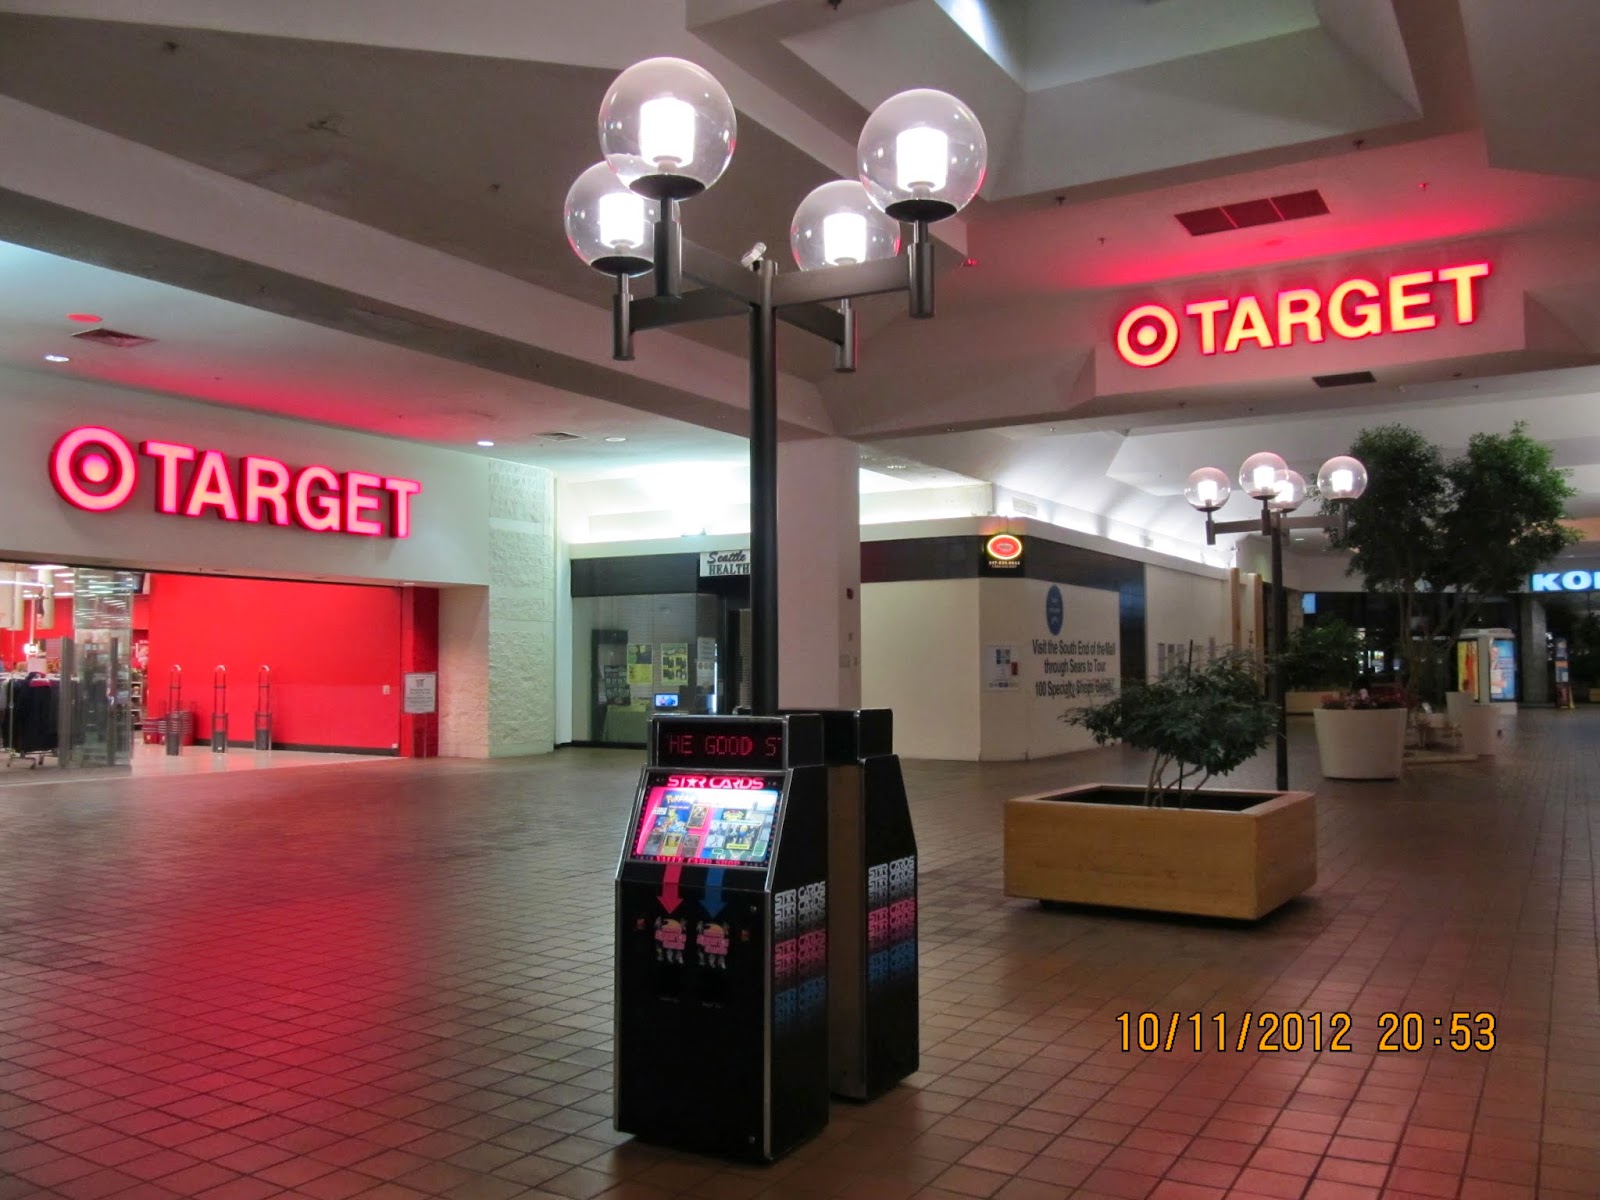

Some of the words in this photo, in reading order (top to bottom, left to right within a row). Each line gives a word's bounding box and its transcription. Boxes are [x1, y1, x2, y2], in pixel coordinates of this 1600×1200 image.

[1186, 263, 1490, 355] TARGET
[140, 440, 421, 539] TARGET
[707, 550, 746, 564] Seattle
[709, 563, 750, 576] HEALTH
[1032, 639, 1047, 655] Visit
[1047, 640, 1058, 655] the
[1059, 640, 1077, 655] South
[1078, 641, 1089, 656] End
[1090, 642, 1096, 655] of
[1044, 658, 1069, 677] through
[1070, 659, 1086, 673] Sears
[1087, 660, 1093, 673] to
[1093, 659, 1107, 673] Tour
[1035, 681, 1047, 697] 100
[1047, 680, 1076, 699] Specialty
[667, 735, 694, 754] HE
[705, 735, 753, 756] GOOD
[667, 775, 707, 788] STAR
[709, 776, 764, 790] CARDS
